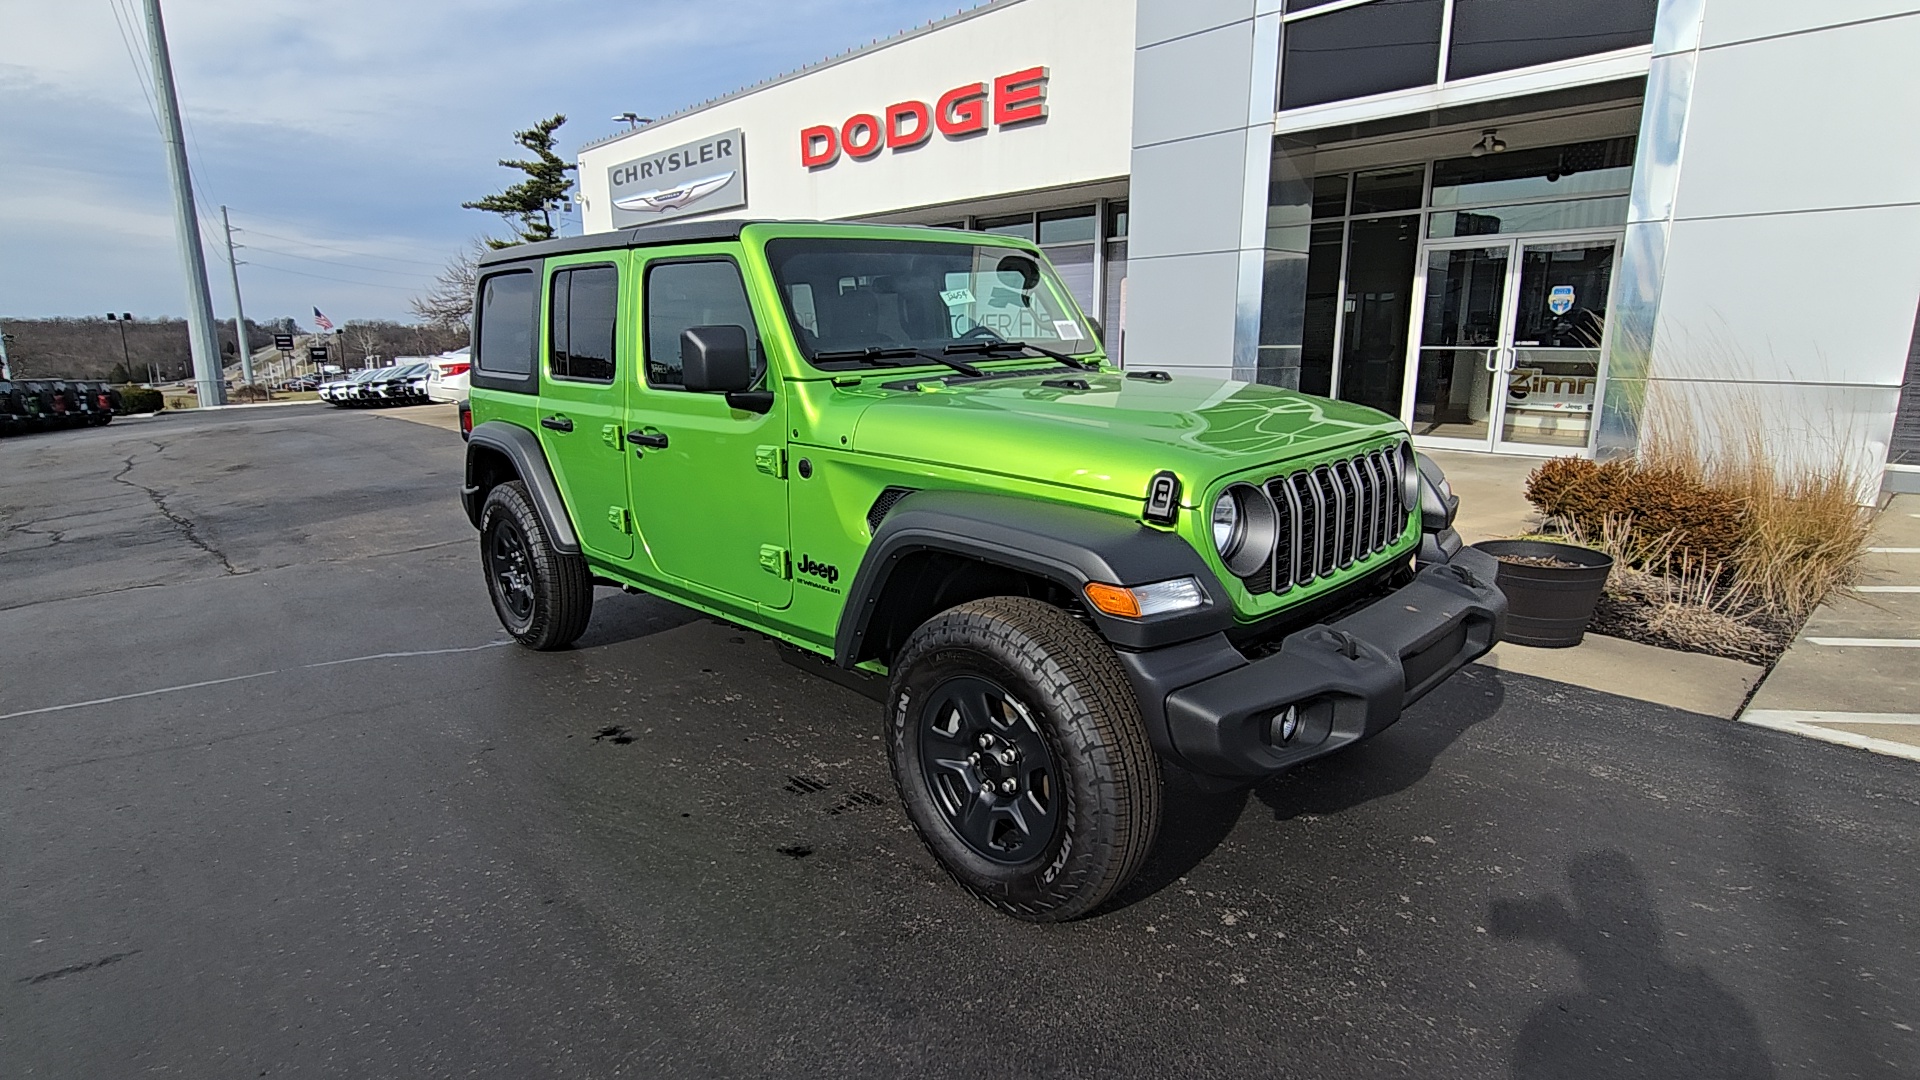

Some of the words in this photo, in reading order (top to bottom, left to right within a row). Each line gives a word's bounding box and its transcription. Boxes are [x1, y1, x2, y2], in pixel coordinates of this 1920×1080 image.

[801, 66, 1049, 171] DODGE
[612, 138, 732, 187] CHRYSLER
[797, 554, 839, 584] Jeep
[803, 580, 841, 595] WRANGLER
[1043, 831, 1073, 884] HTX2
